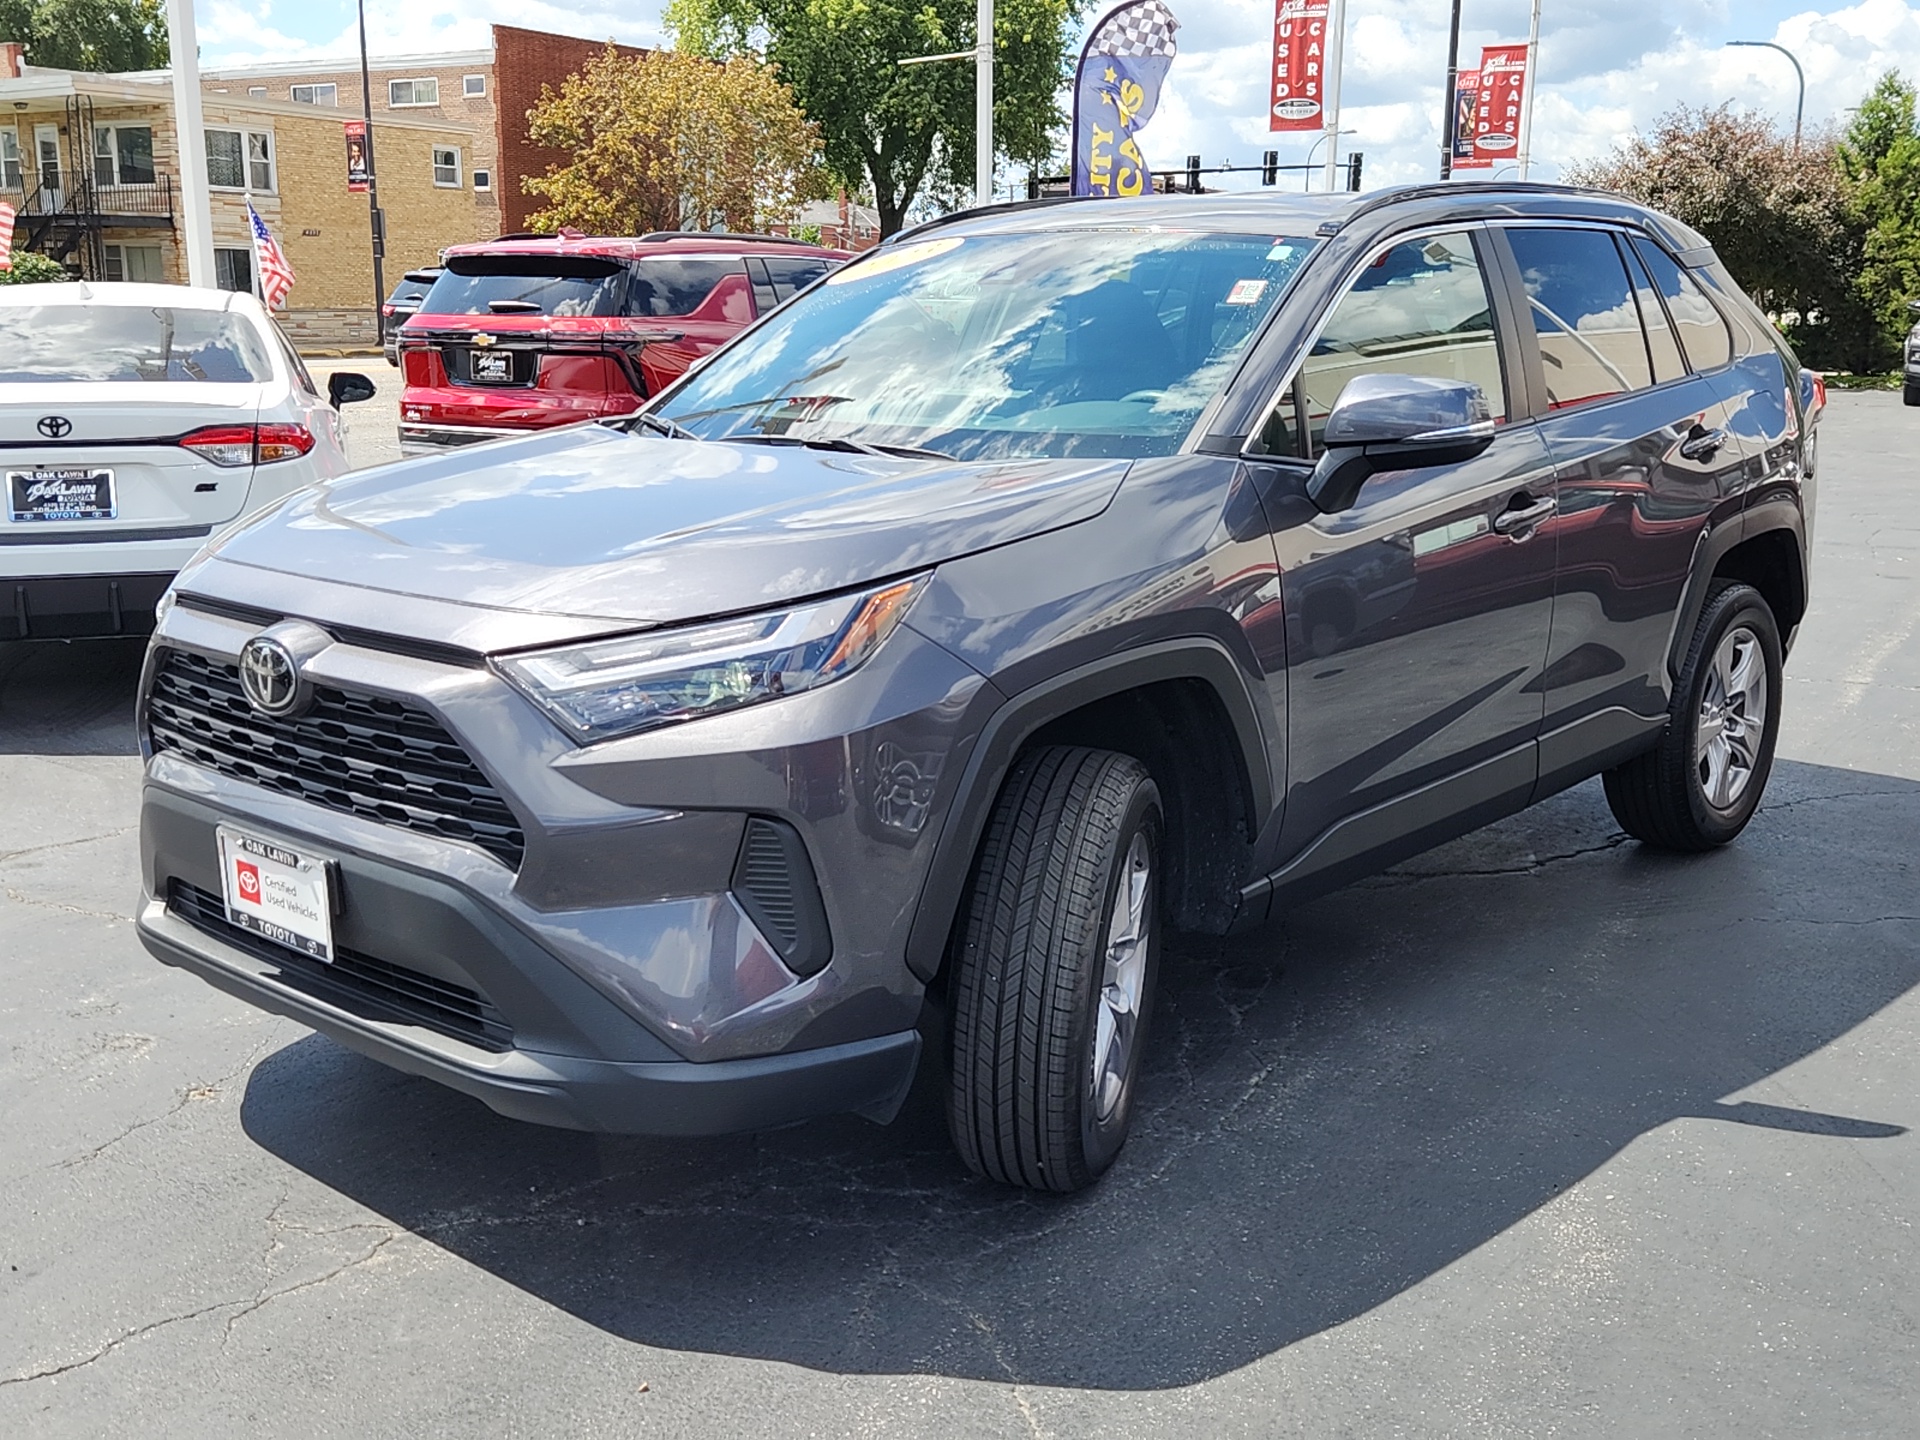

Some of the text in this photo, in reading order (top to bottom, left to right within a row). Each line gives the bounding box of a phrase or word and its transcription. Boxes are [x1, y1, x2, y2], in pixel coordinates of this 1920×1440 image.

[1276, 23, 1292, 97] USED
[1306, 22, 1321, 97] CARS
[1478, 75, 1494, 133] USED
[1504, 74, 1520, 133] CARS
[44, 511, 82, 519] TOYOTA
[246, 840, 266, 856] OAK
[265, 875, 297, 897] Certified
[266, 891, 319, 922] Used Vehicles
[258, 920, 297, 946] TOYOTA
